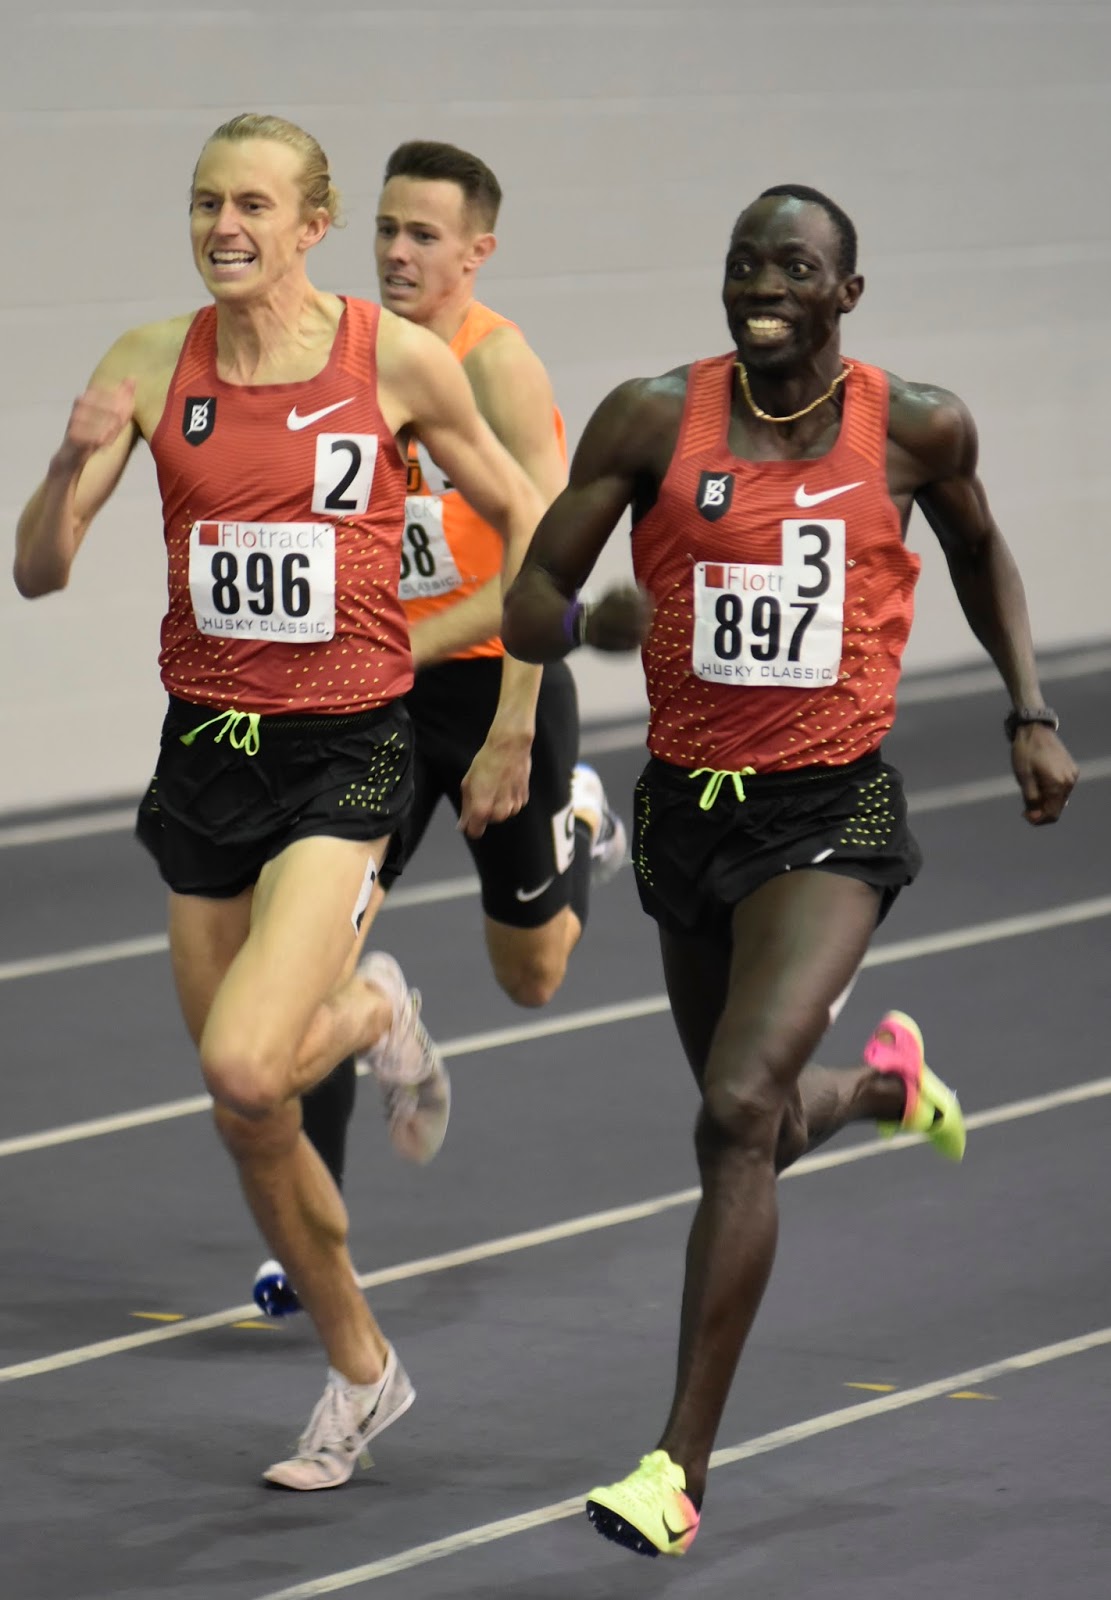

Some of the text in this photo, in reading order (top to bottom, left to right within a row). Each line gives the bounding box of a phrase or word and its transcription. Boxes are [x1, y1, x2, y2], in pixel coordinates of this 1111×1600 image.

[325, 439, 362, 510] 2
[222, 523, 325, 548] Flotrack
[211, 551, 311, 617] 896
[727, 566, 784, 592] Flotr
[797, 524, 831, 598] 3
[203, 617, 326, 633] HUSKY CLASSIC
[714, 594, 819, 662] 897
[702, 663, 832, 680] HUSKY CLASSIC
